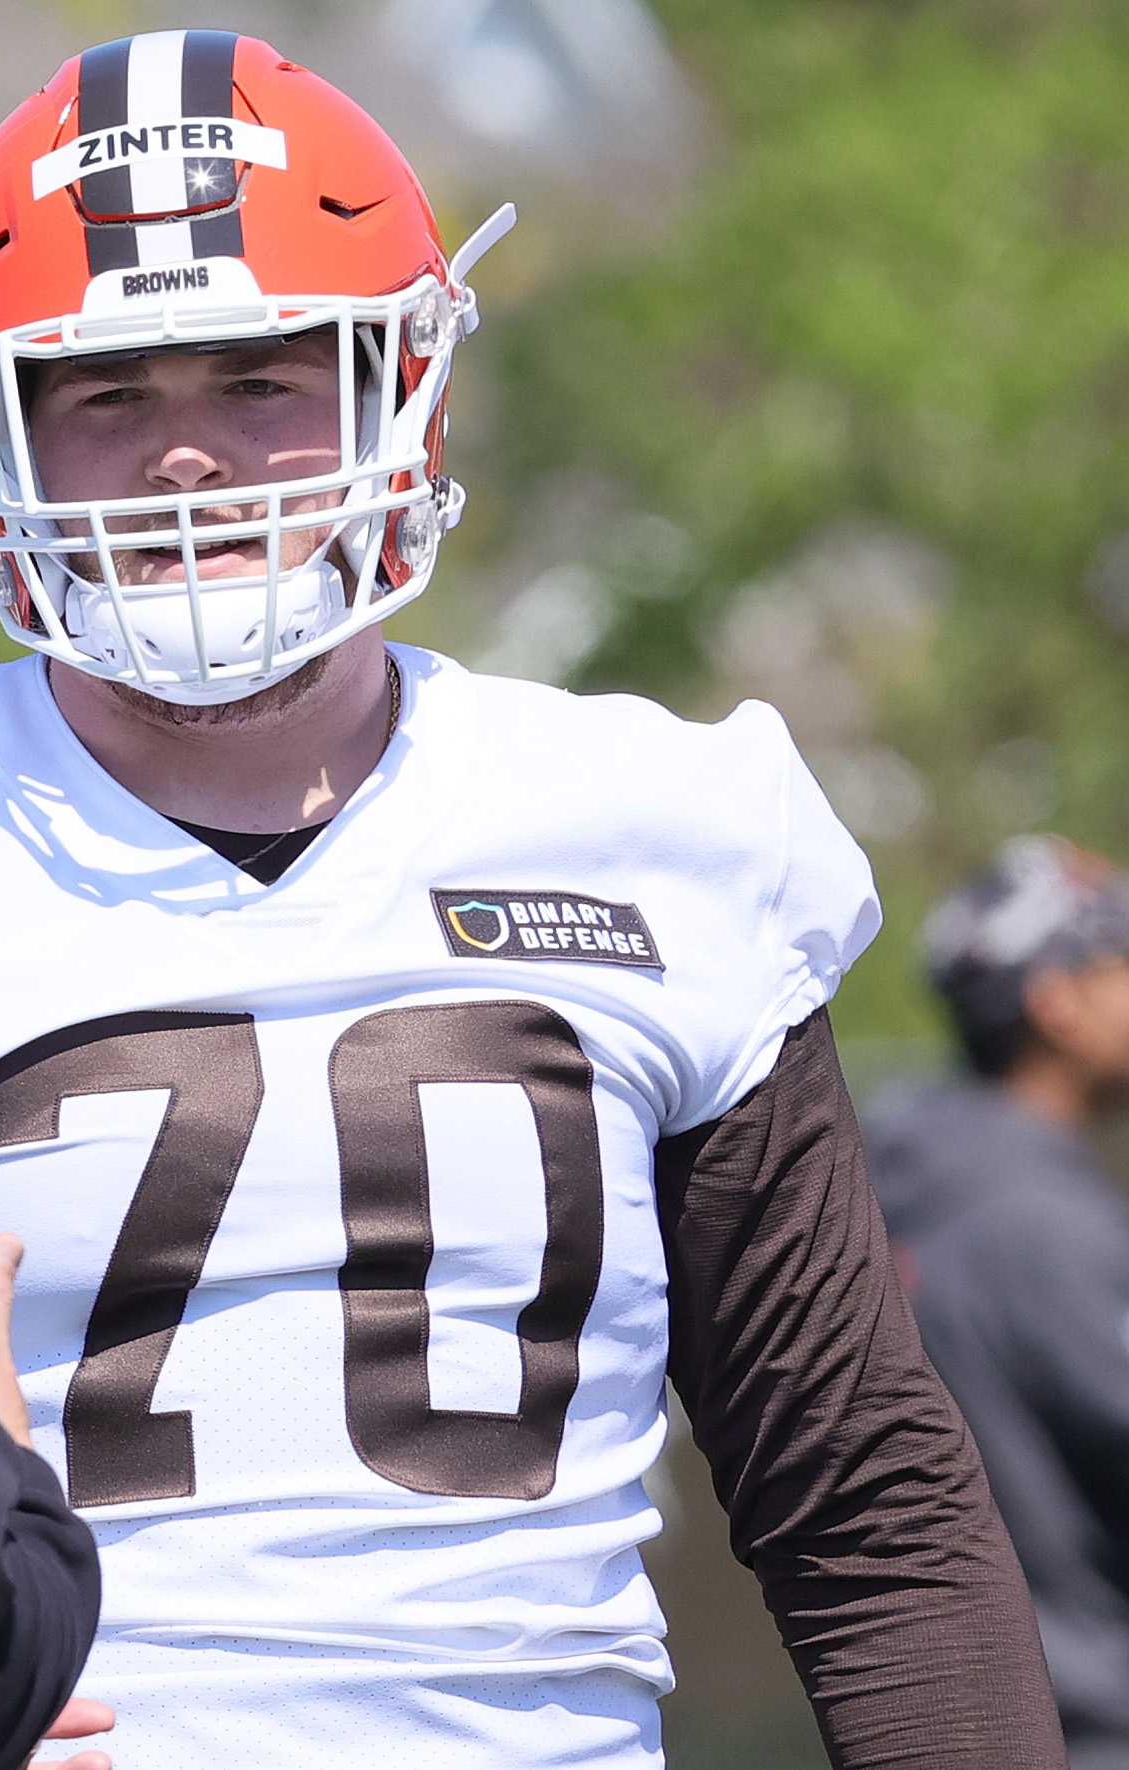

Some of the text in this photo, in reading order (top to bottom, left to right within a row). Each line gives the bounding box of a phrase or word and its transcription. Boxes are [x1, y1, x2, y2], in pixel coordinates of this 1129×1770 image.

[78, 124, 233, 168] ZINTER
[122, 266, 209, 297] BROWNS
[508, 902, 613, 927] BINARY
[518, 927, 650, 956] DEFENSE
